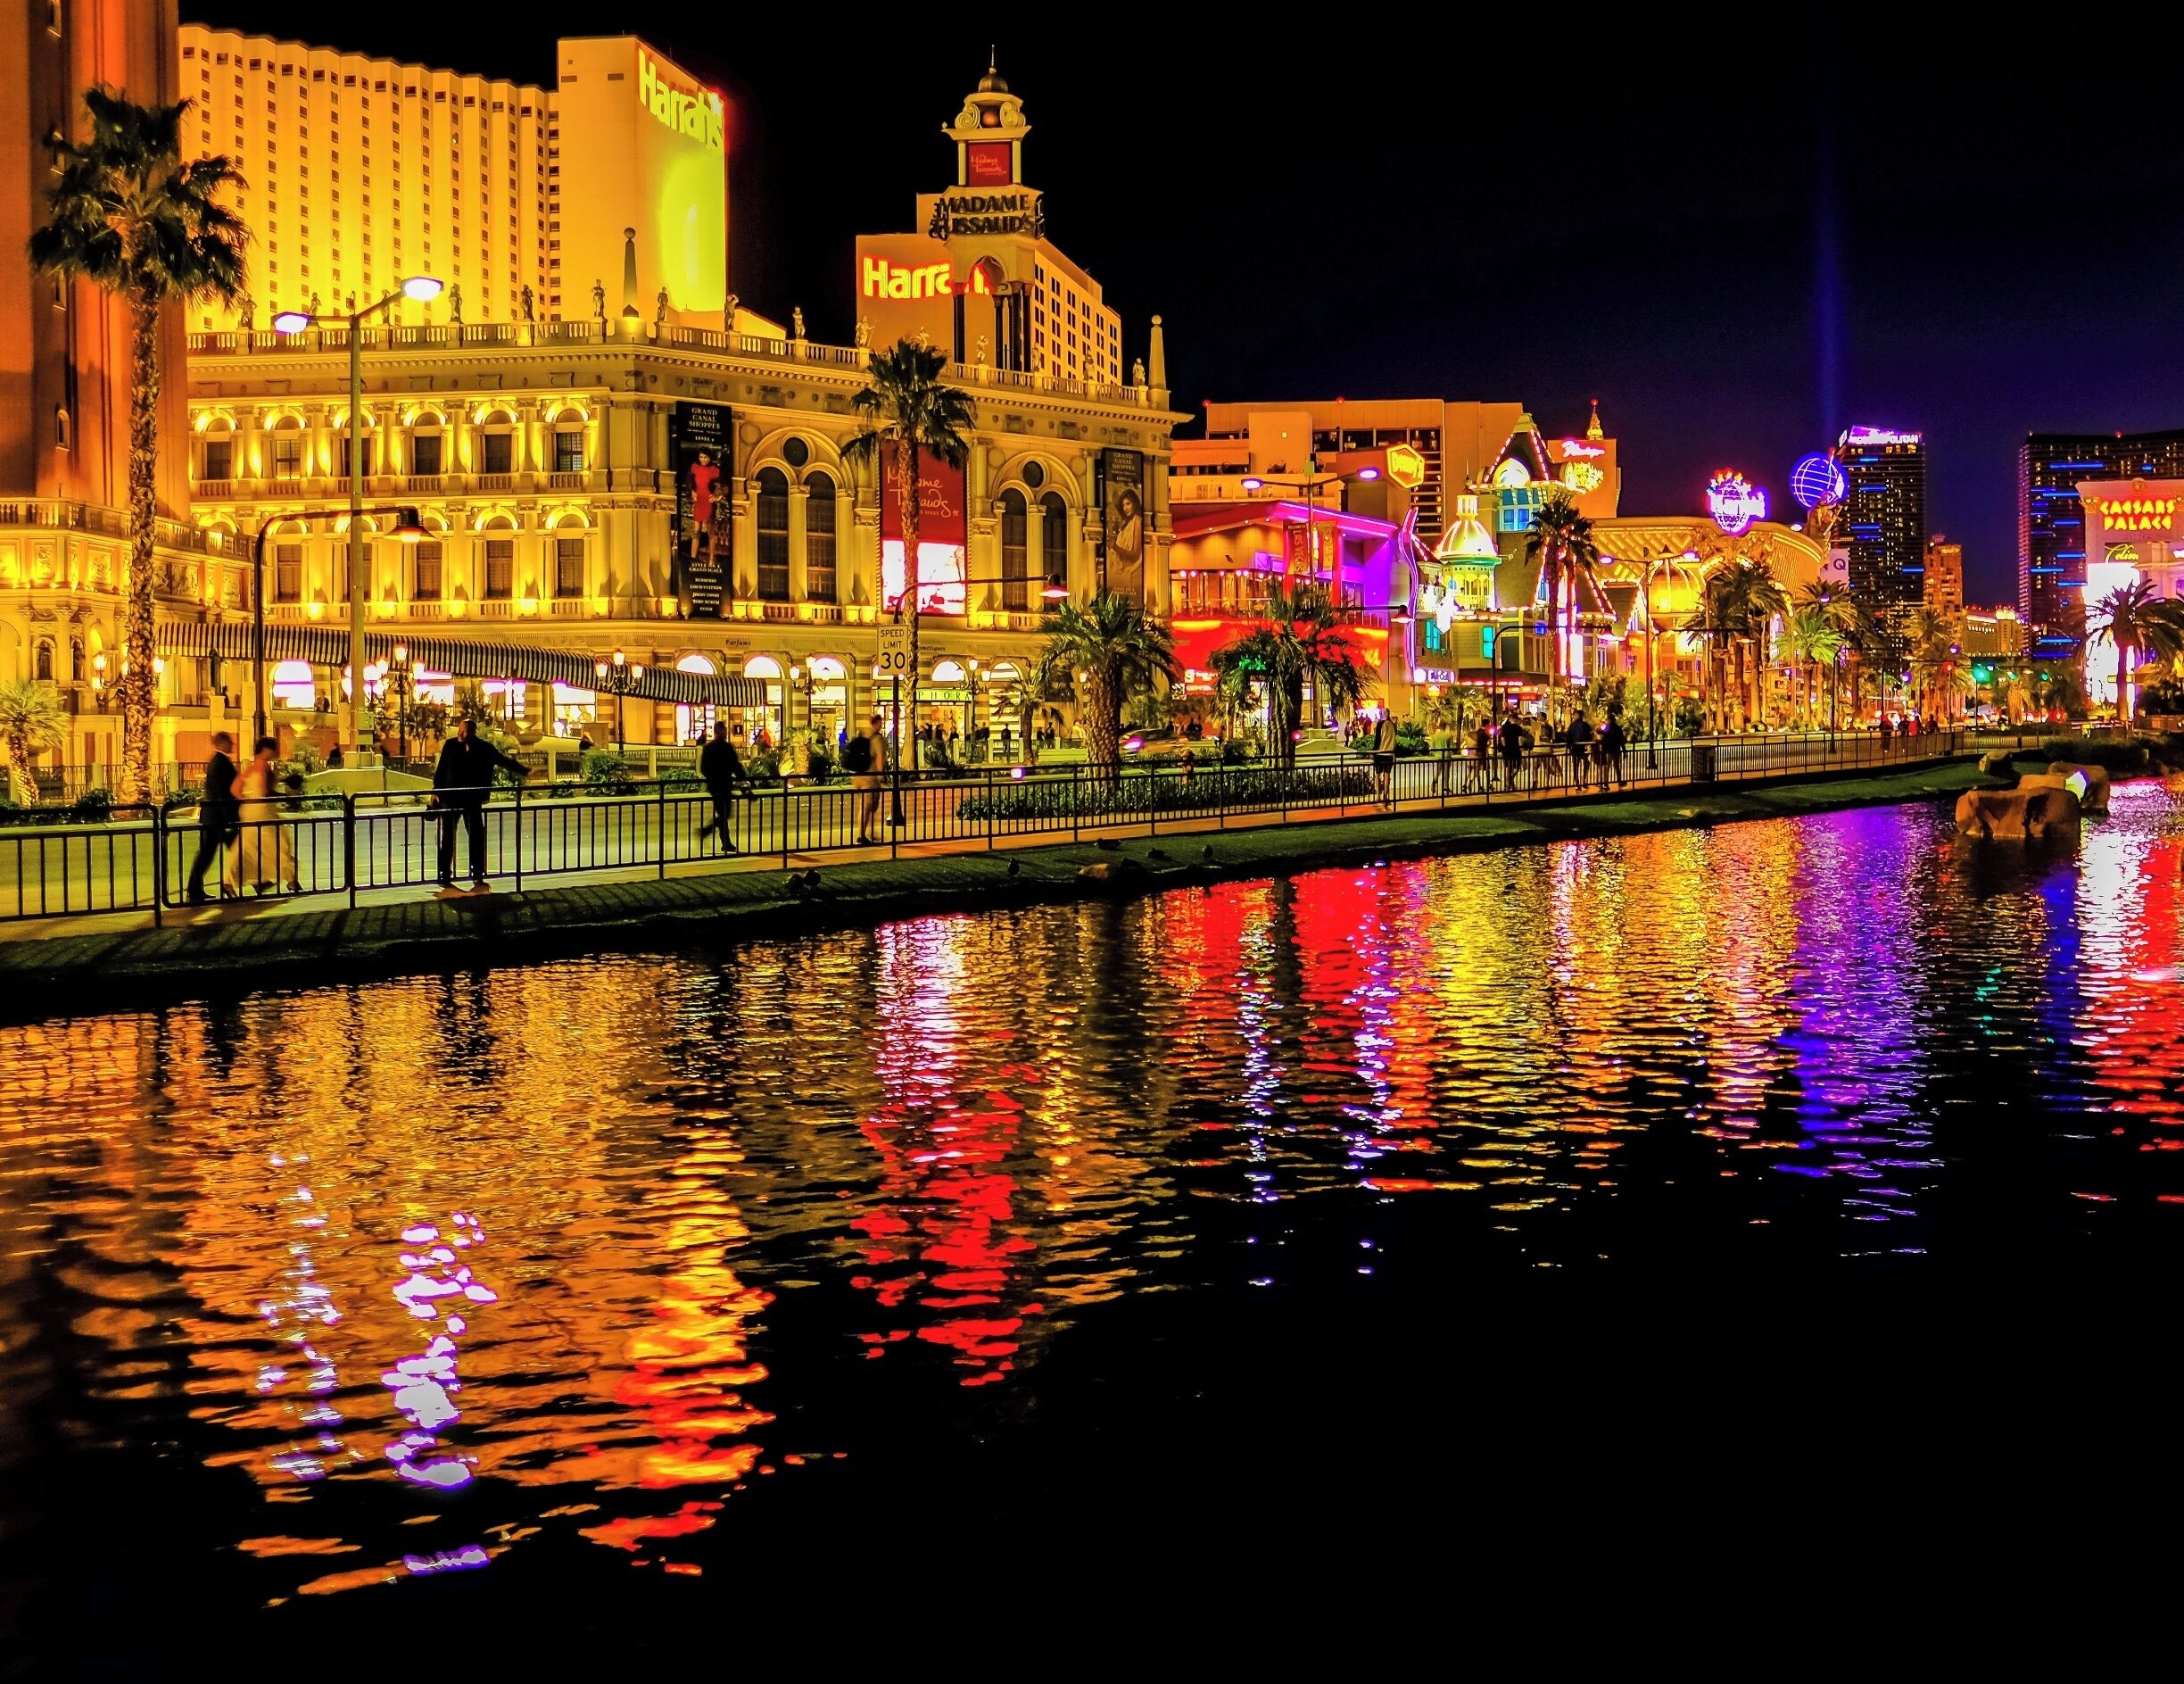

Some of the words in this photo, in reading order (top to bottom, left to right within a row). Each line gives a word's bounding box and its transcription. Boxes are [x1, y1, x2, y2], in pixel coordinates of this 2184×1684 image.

[940, 195, 1030, 214] MADAME
[691, 407, 717, 416] GRAND
[689, 420, 721, 429] SHOPPES
[692, 414, 716, 423] CANAL
[889, 488, 951, 518] Tauds
[2099, 500, 2175, 515] CAESARS
[2104, 515, 2172, 531] PALACE
[1833, 559, 1847, 570] Q
[880, 629, 905, 638] SPEED
[882, 641, 902, 650] LIMIT
[880, 651, 906, 670] 30
[918, 688, 972, 701] PHORA
